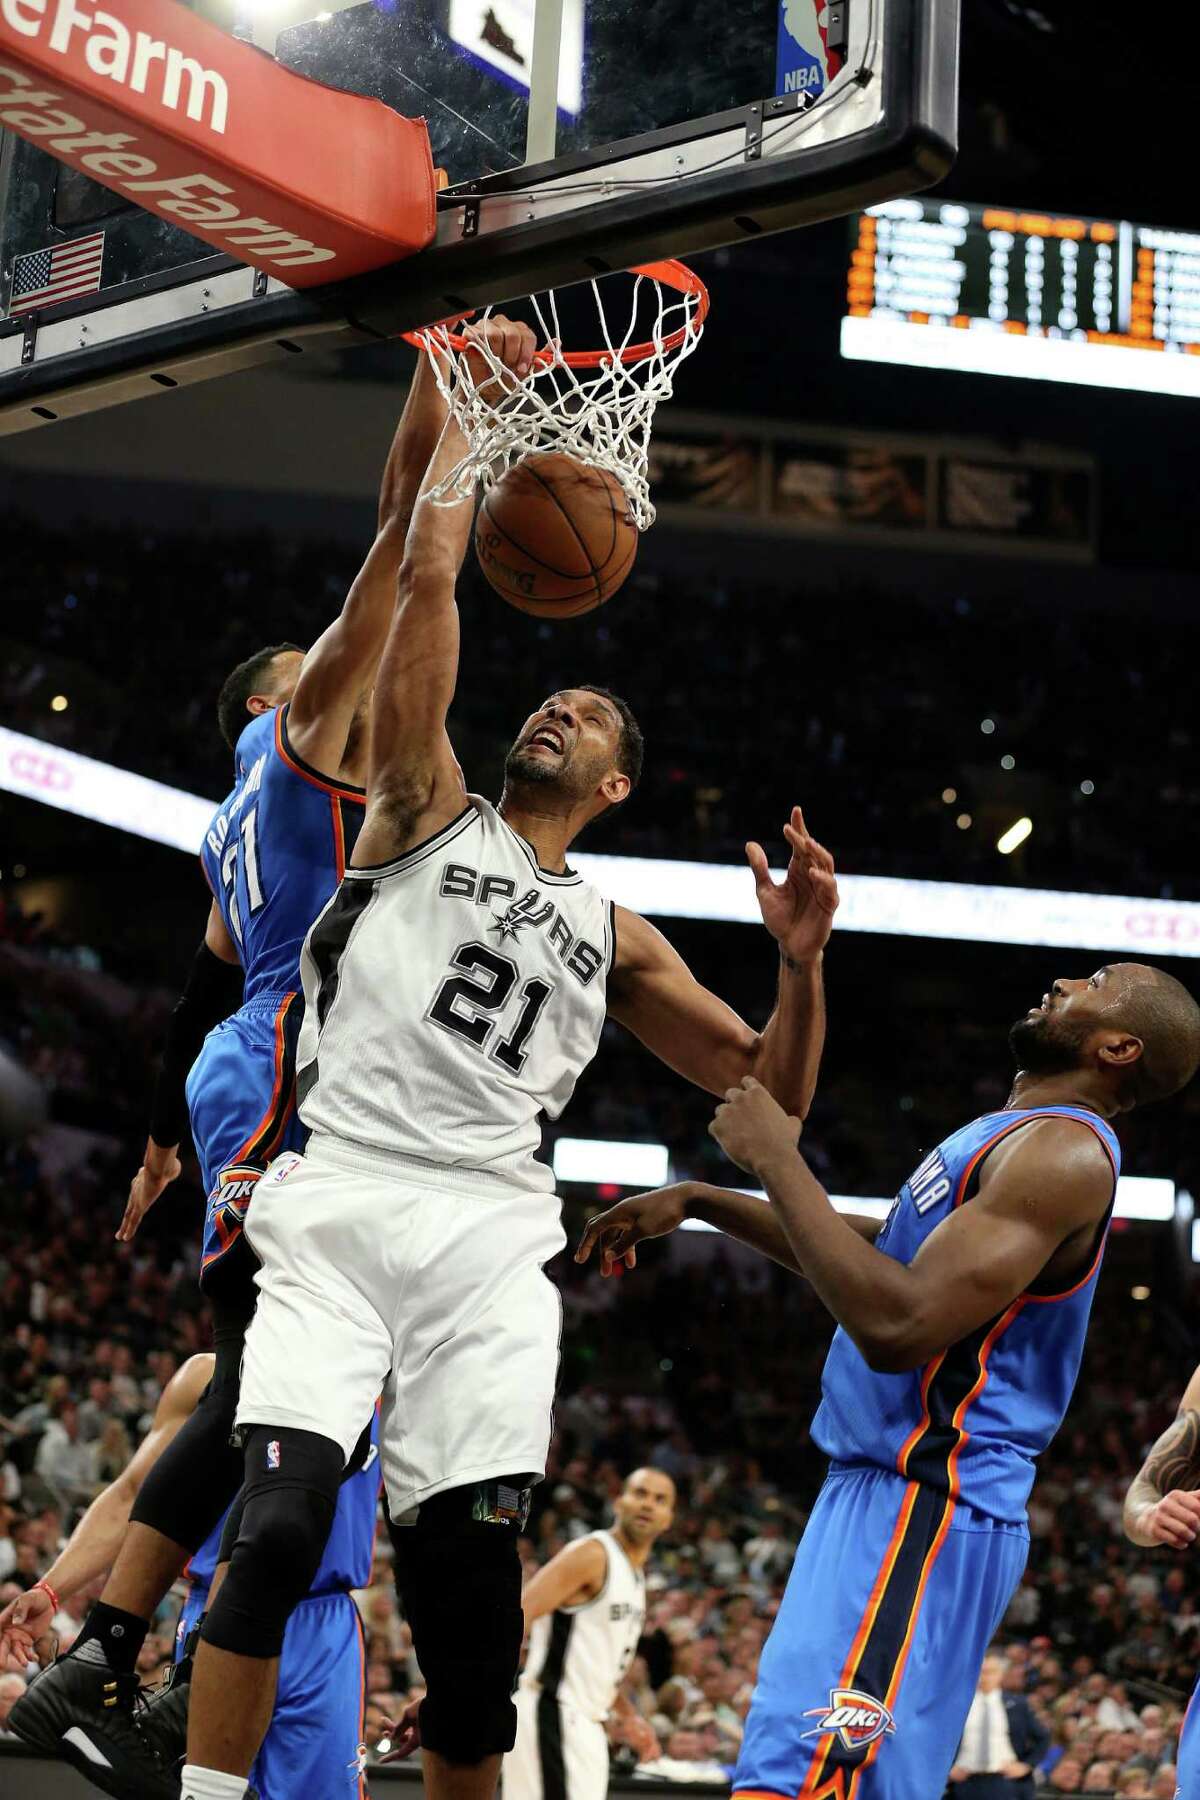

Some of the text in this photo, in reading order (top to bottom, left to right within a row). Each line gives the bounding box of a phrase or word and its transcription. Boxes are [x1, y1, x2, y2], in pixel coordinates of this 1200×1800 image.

[784, 66, 820, 92] NBA
[439, 861, 606, 986] SPURS
[424, 940, 556, 1077] 21
[820, 1705, 881, 1728] OKC
